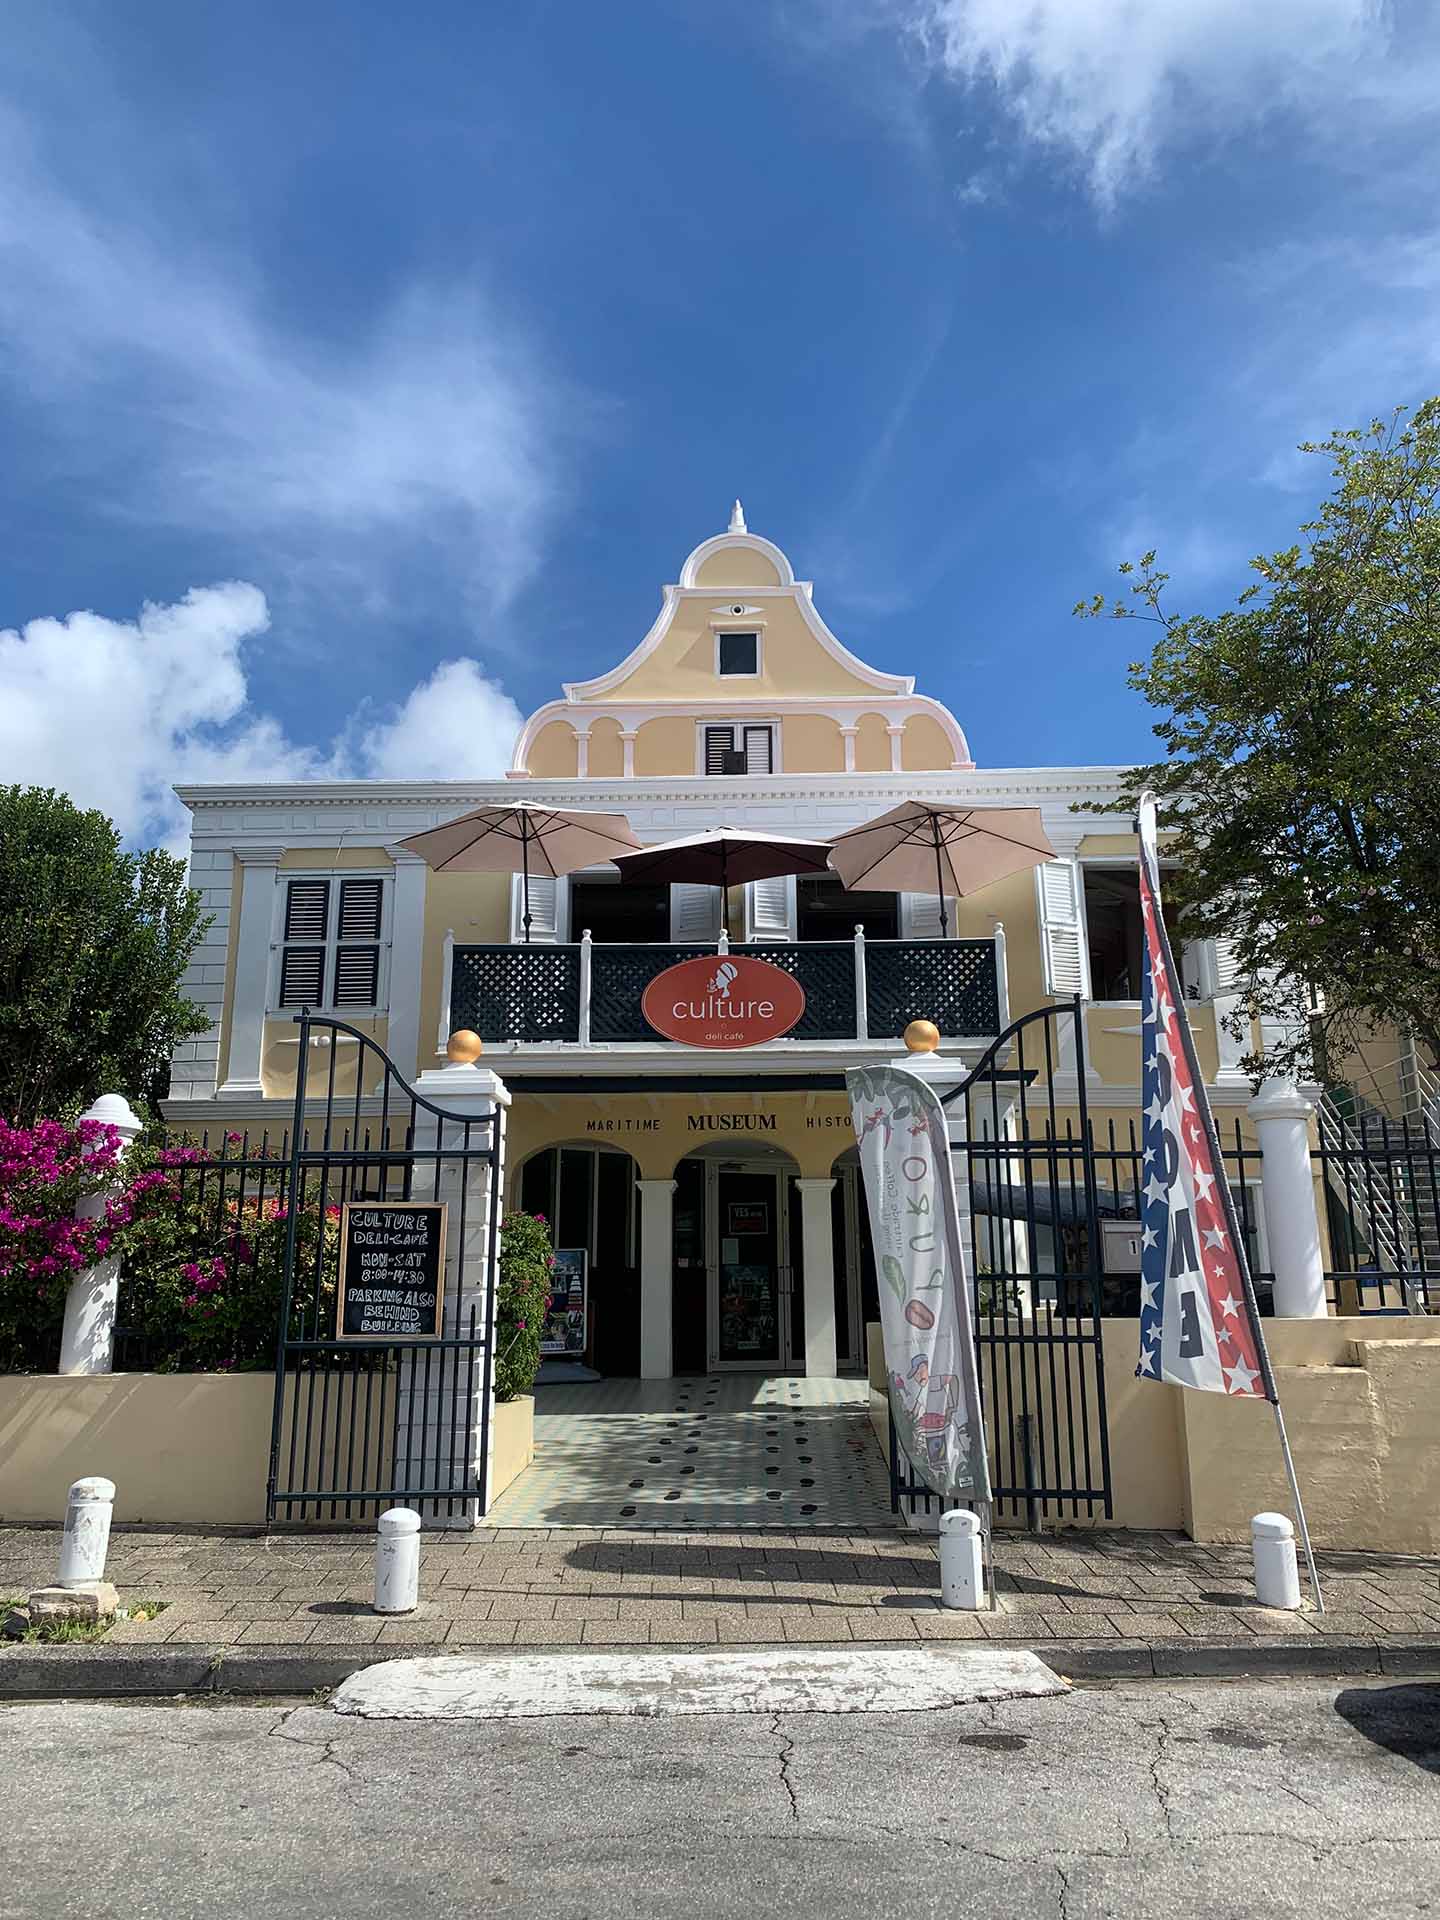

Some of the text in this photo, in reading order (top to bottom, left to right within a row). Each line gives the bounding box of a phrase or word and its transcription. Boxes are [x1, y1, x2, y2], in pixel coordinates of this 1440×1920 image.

[672, 995, 775, 1019] culture
[705, 1032, 744, 1041] deli café
[586, 1114, 852, 1131] MARITIME MUSEUM HISTO
[350, 1211, 428, 1231] CULTURE
[348, 1288, 435, 1307] PARKING ALSO
[364, 1305, 420, 1321] BEHIND
